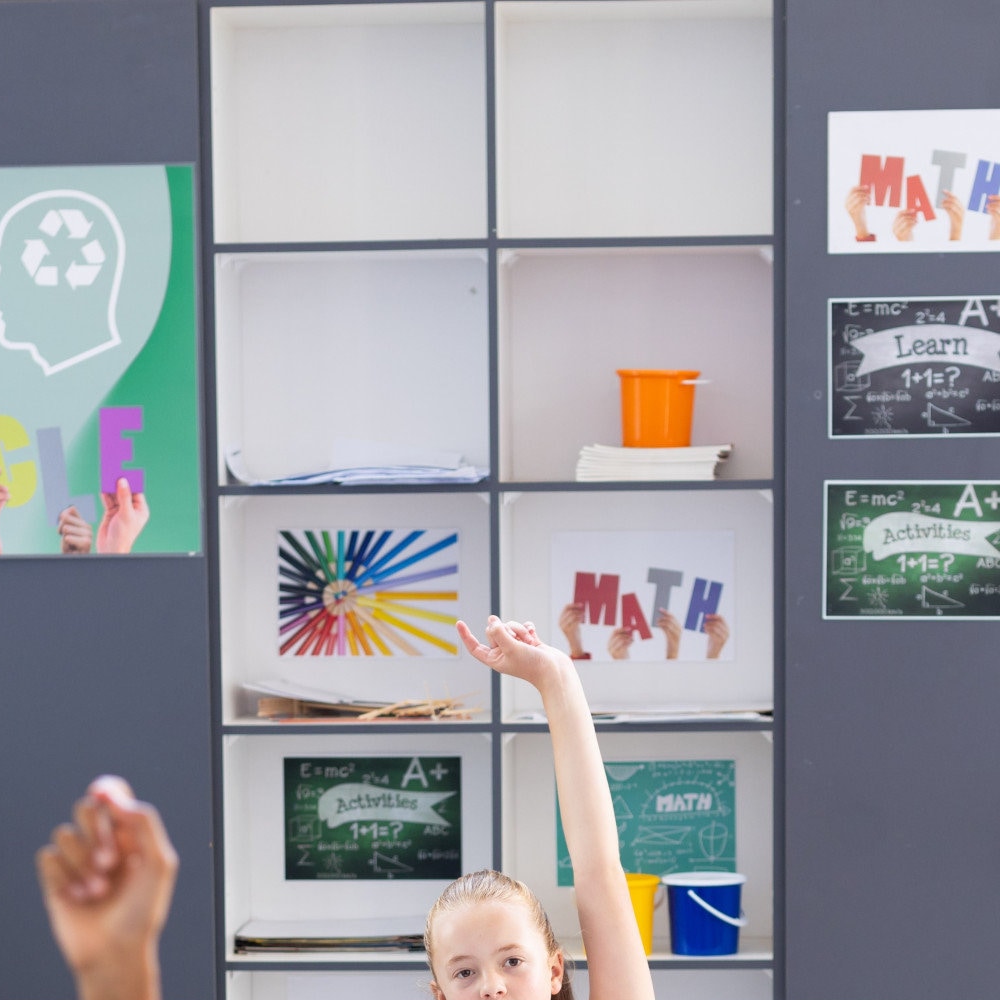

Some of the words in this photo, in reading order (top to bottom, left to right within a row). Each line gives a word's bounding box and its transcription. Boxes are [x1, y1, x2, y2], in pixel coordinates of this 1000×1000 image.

[860, 149, 1000, 221] MATH
[894, 334, 968, 358] Learn
[901, 366, 961, 388] 1+1=?
[882, 523, 971, 545] Activities
[897, 553, 955, 573] 1+1=?
[574, 567, 724, 640] MATH
[401, 757, 449, 788] A+
[336, 794, 418, 814] Activities
[656, 793, 712, 813] MATH
